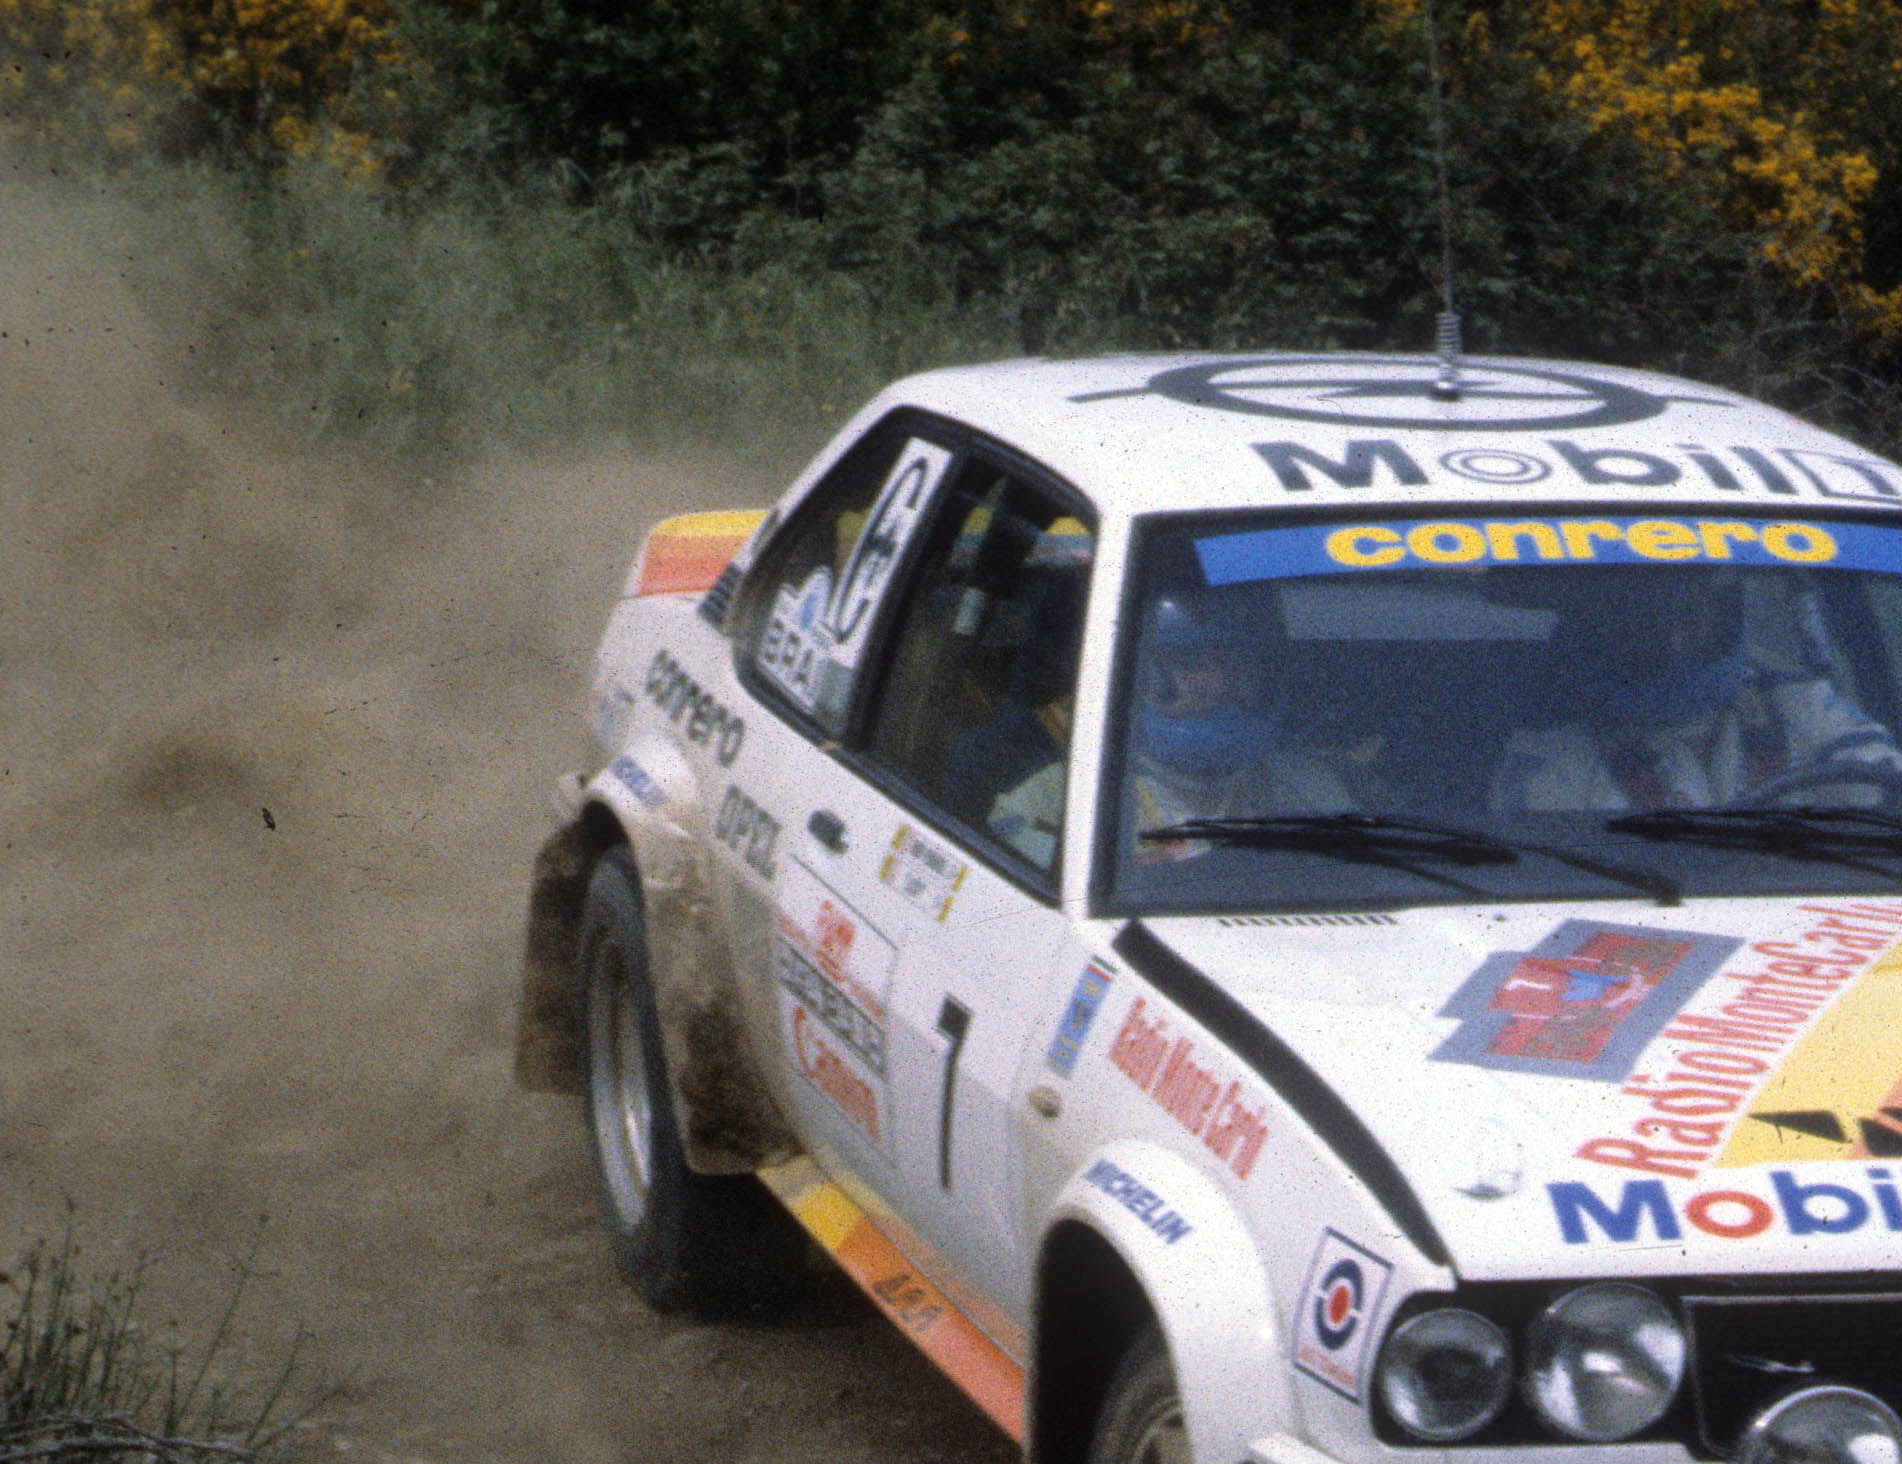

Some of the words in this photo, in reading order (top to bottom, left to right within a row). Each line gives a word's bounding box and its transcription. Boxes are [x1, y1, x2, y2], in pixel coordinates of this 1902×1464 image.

[1251, 438, 1798, 495] Mobil
[1325, 520, 1839, 568] conrero
[646, 650, 745, 768] conrero
[1084, 1157, 1193, 1246] MICHELIN
